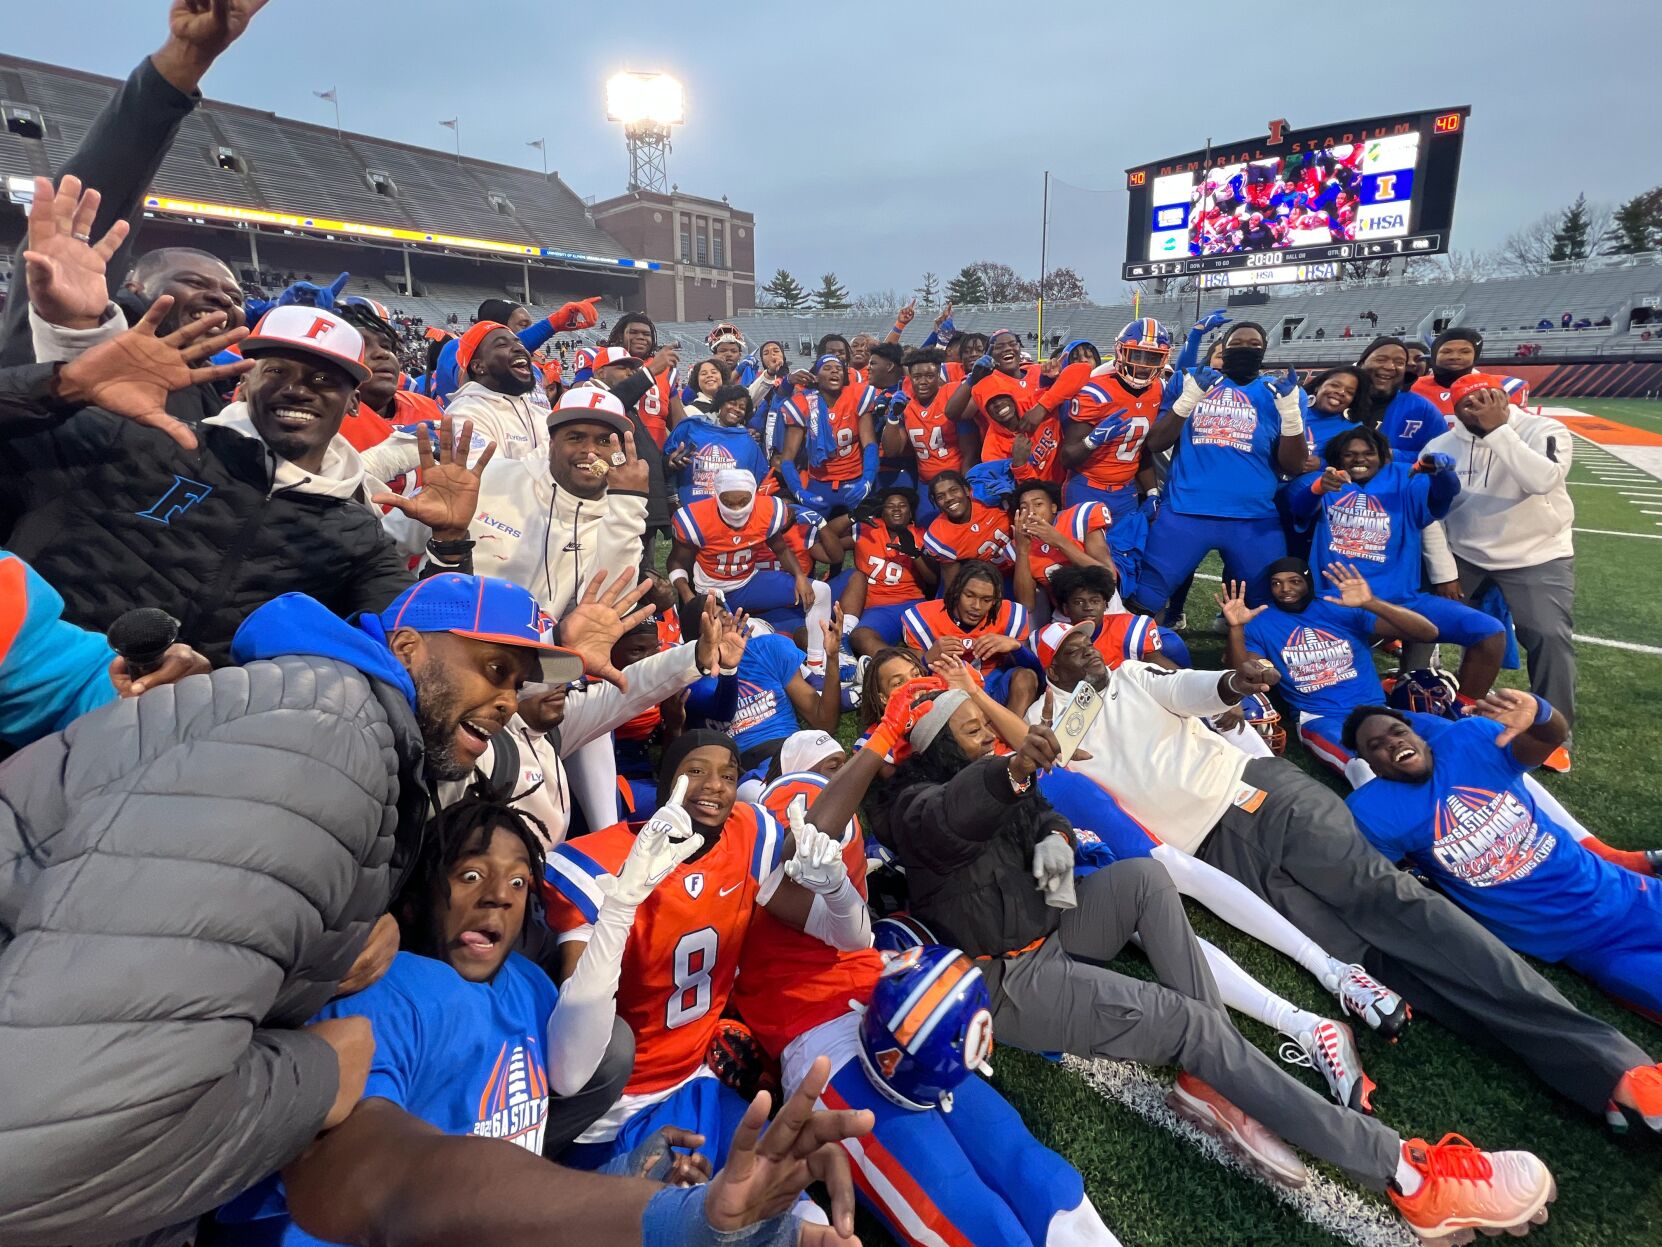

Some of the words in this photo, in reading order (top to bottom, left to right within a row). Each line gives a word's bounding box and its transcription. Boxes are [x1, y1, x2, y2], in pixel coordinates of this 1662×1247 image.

[1435, 115, 1460, 131] 40
[1160, 150, 1264, 176] MEMORIAL
[1291, 122, 1411, 154] STADIUM
[1130, 172, 1146, 186] 40
[1151, 264, 1166, 275] 57
[1247, 253, 1283, 266] 20:00
[306, 316, 336, 340] F
[588, 391, 607, 409] F
[1221, 400, 1240, 408] STATE
[1194, 401, 1257, 423] CHAMPIONS
[505, 432, 529, 442] FLYERS
[1115, 415, 1150, 462] 0
[1398, 419, 1424, 439] F
[908, 425, 949, 460] 54
[1031, 427, 1053, 466] YERS
[1230, 441, 1253, 453] FLYERS
[134, 474, 214, 526] F
[1101, 506, 1112, 525] 9
[1327, 507, 1391, 534] CHAMPIONS
[1355, 508, 1375, 517] STATE
[477, 511, 523, 539] FLYERS
[566, 540, 582, 549] NIKE
[1361, 553, 1387, 563] FLYERS
[866, 555, 903, 586] 78
[1281, 640, 1353, 670] CHAMPIONS
[1298, 643, 1309, 651] 6A
[1309, 641, 1329, 651] STATE
[524, 770, 544, 784] FLY
[1433, 792, 1526, 872] CHAMPIONS
[1451, 824, 1469, 840] 6A
[1465, 805, 1493, 834] STATE
[1510, 858, 1538, 880] LOUIS
[1533, 834, 1557, 862] FLYERS
[690, 875, 700, 893] F
[665, 924, 719, 1031] 8
[492, 1109, 509, 1138] 6A
[510, 1098, 541, 1136] STAT
